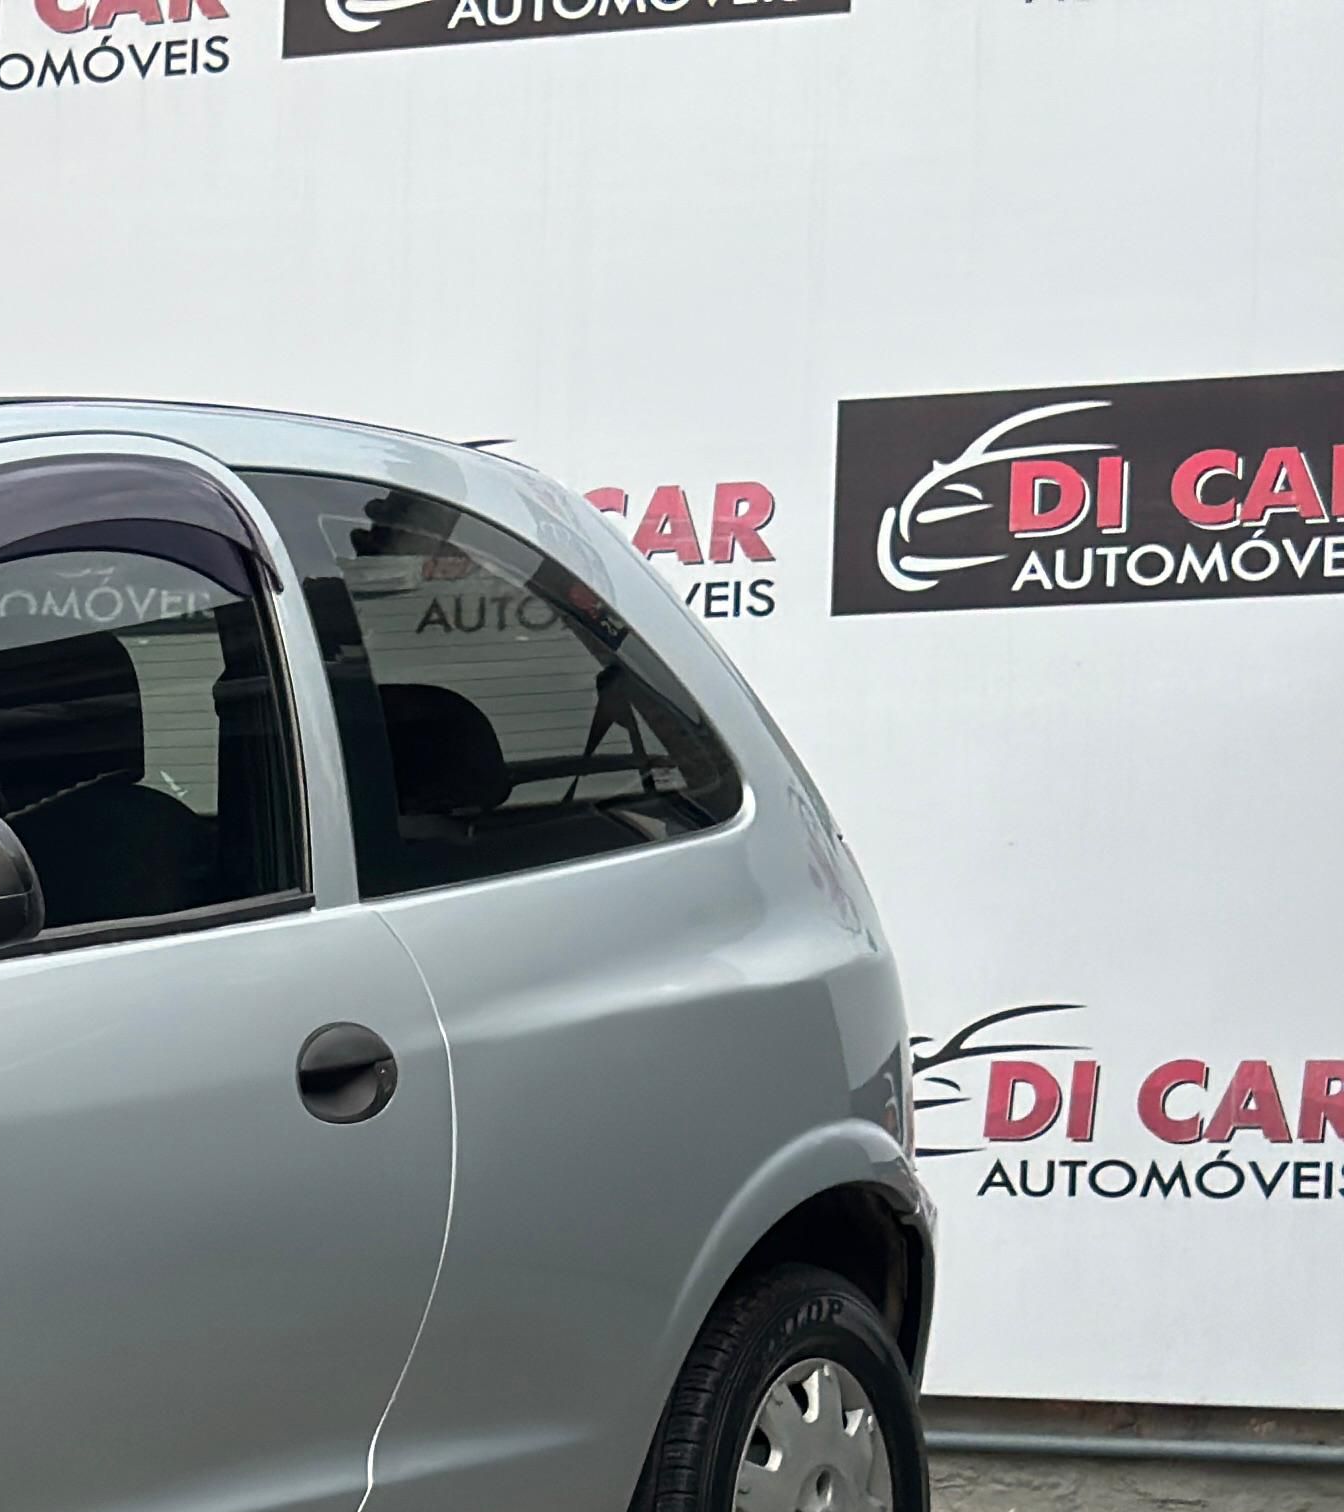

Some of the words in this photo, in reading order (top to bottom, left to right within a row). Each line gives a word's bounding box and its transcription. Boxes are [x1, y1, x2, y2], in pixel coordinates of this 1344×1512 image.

[1008, 455, 1129, 538] DI
[1170, 443, 1344, 531] CA
[1011, 529, 1344, 592] AUTOMÓVE
[983, 1059, 1101, 1143] DI
[976, 1149, 1344, 1200] AUTOMÓVEI
